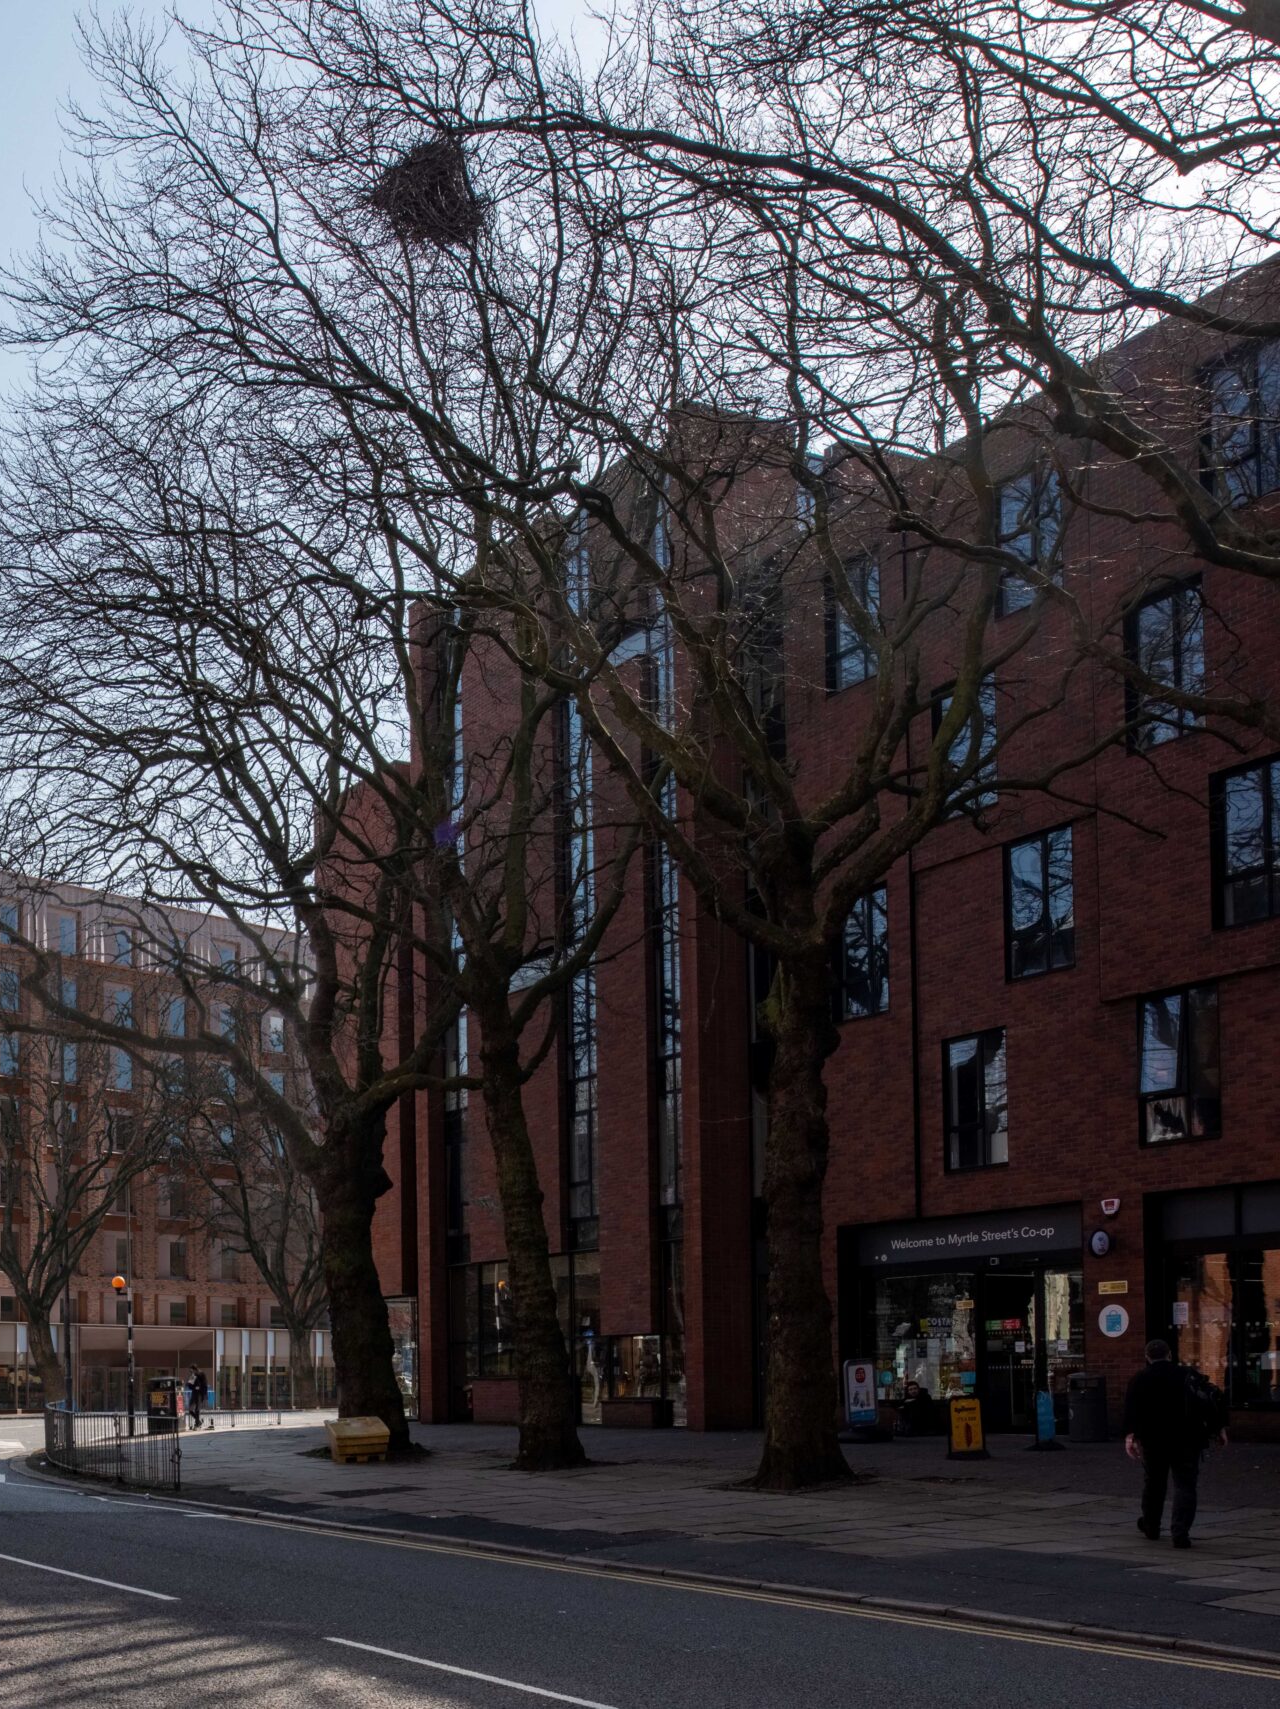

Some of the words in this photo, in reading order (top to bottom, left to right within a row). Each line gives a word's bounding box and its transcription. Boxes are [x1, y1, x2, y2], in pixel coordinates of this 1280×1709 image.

[891, 1237, 933, 1250] Welcome
[936, 1237, 946, 1246] to
[948, 1232, 979, 1247] Myrtle
[981, 1228, 1019, 1242] Street's
[1021, 1227, 1054, 1239] Co-op
